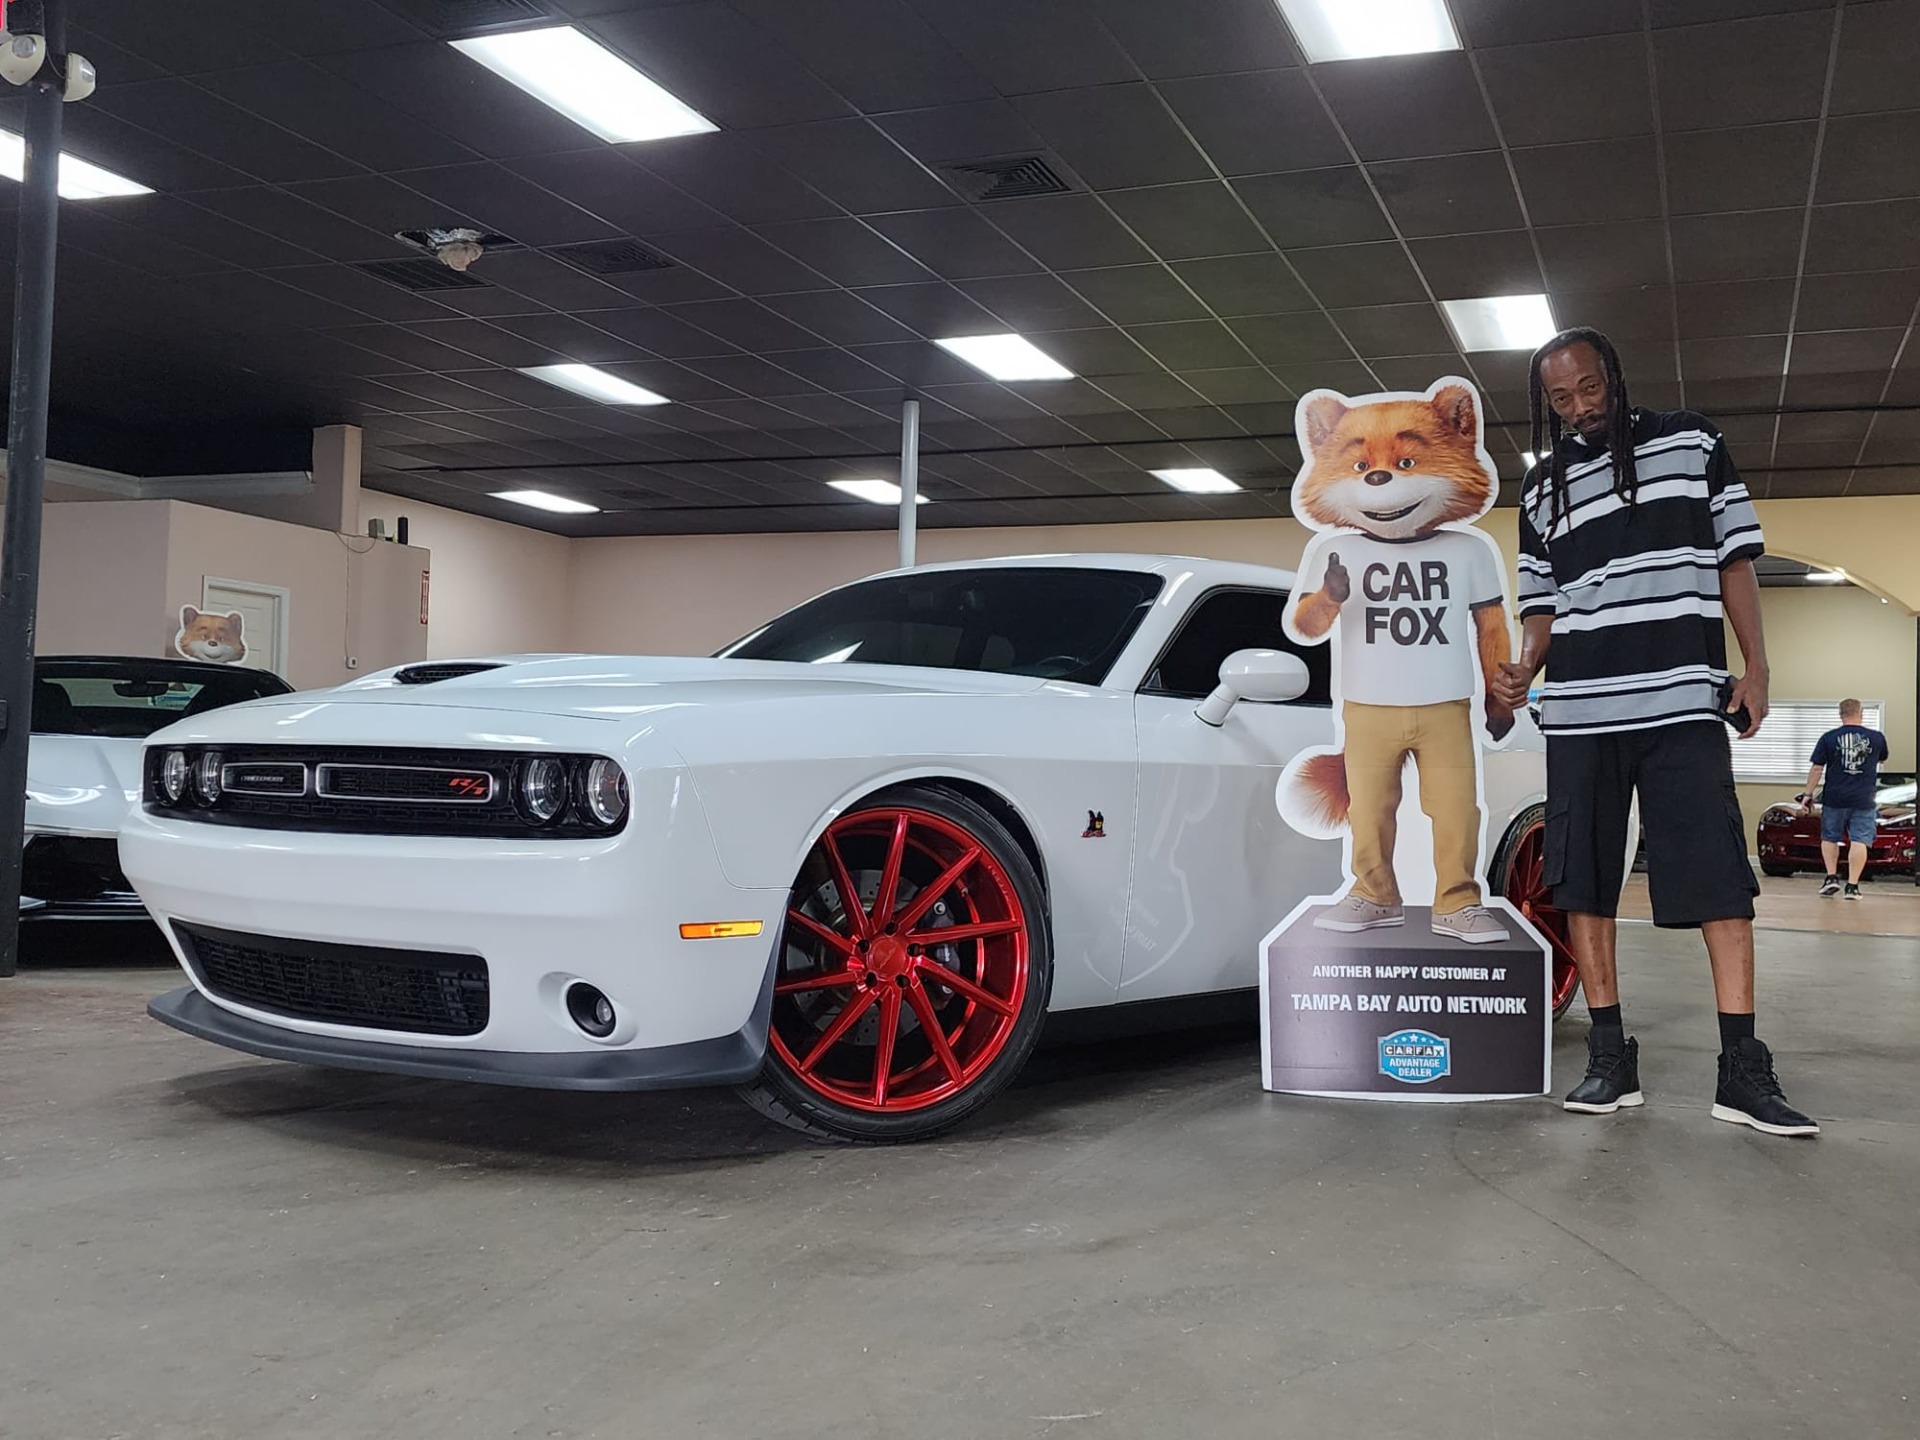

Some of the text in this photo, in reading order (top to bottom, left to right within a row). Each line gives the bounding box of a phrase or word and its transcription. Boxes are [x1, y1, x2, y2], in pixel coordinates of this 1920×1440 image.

[1363, 561, 1450, 602] CAR
[1365, 606, 1450, 646] FOX
[449, 778, 488, 795] R/T
[1312, 965, 1507, 981] ANOTHER HAPPY CUSTOMER AT
[1291, 994, 1527, 1015] TAMPA BAY AUTO NETWORK
[1385, 1045, 1444, 1057] CARFAX
[1389, 1058, 1441, 1068] ADVANTAGE
[1398, 1067, 1432, 1077] DEALER
